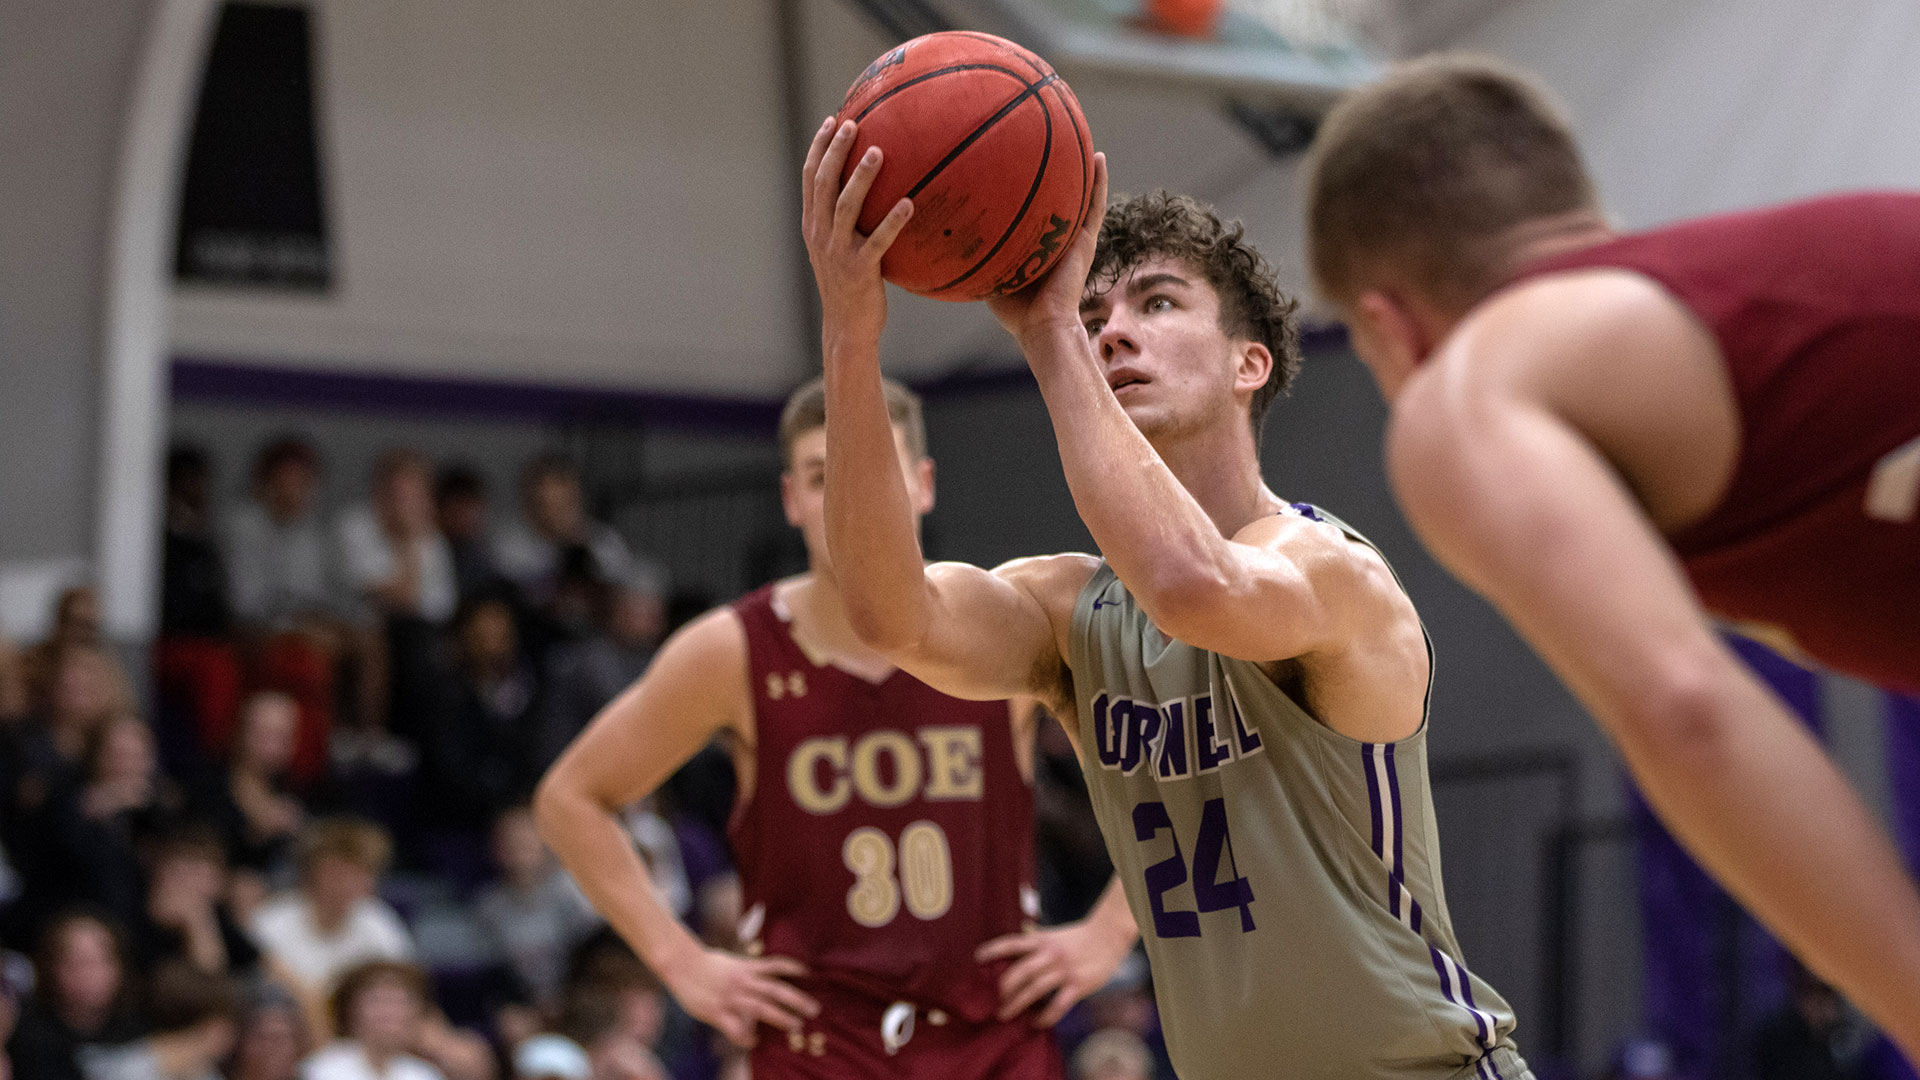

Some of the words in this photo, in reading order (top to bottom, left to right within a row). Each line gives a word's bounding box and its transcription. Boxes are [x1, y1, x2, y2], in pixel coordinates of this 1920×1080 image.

[786, 724, 984, 815] COE
[842, 820, 954, 928] 30
[1132, 798, 1256, 939] 24
